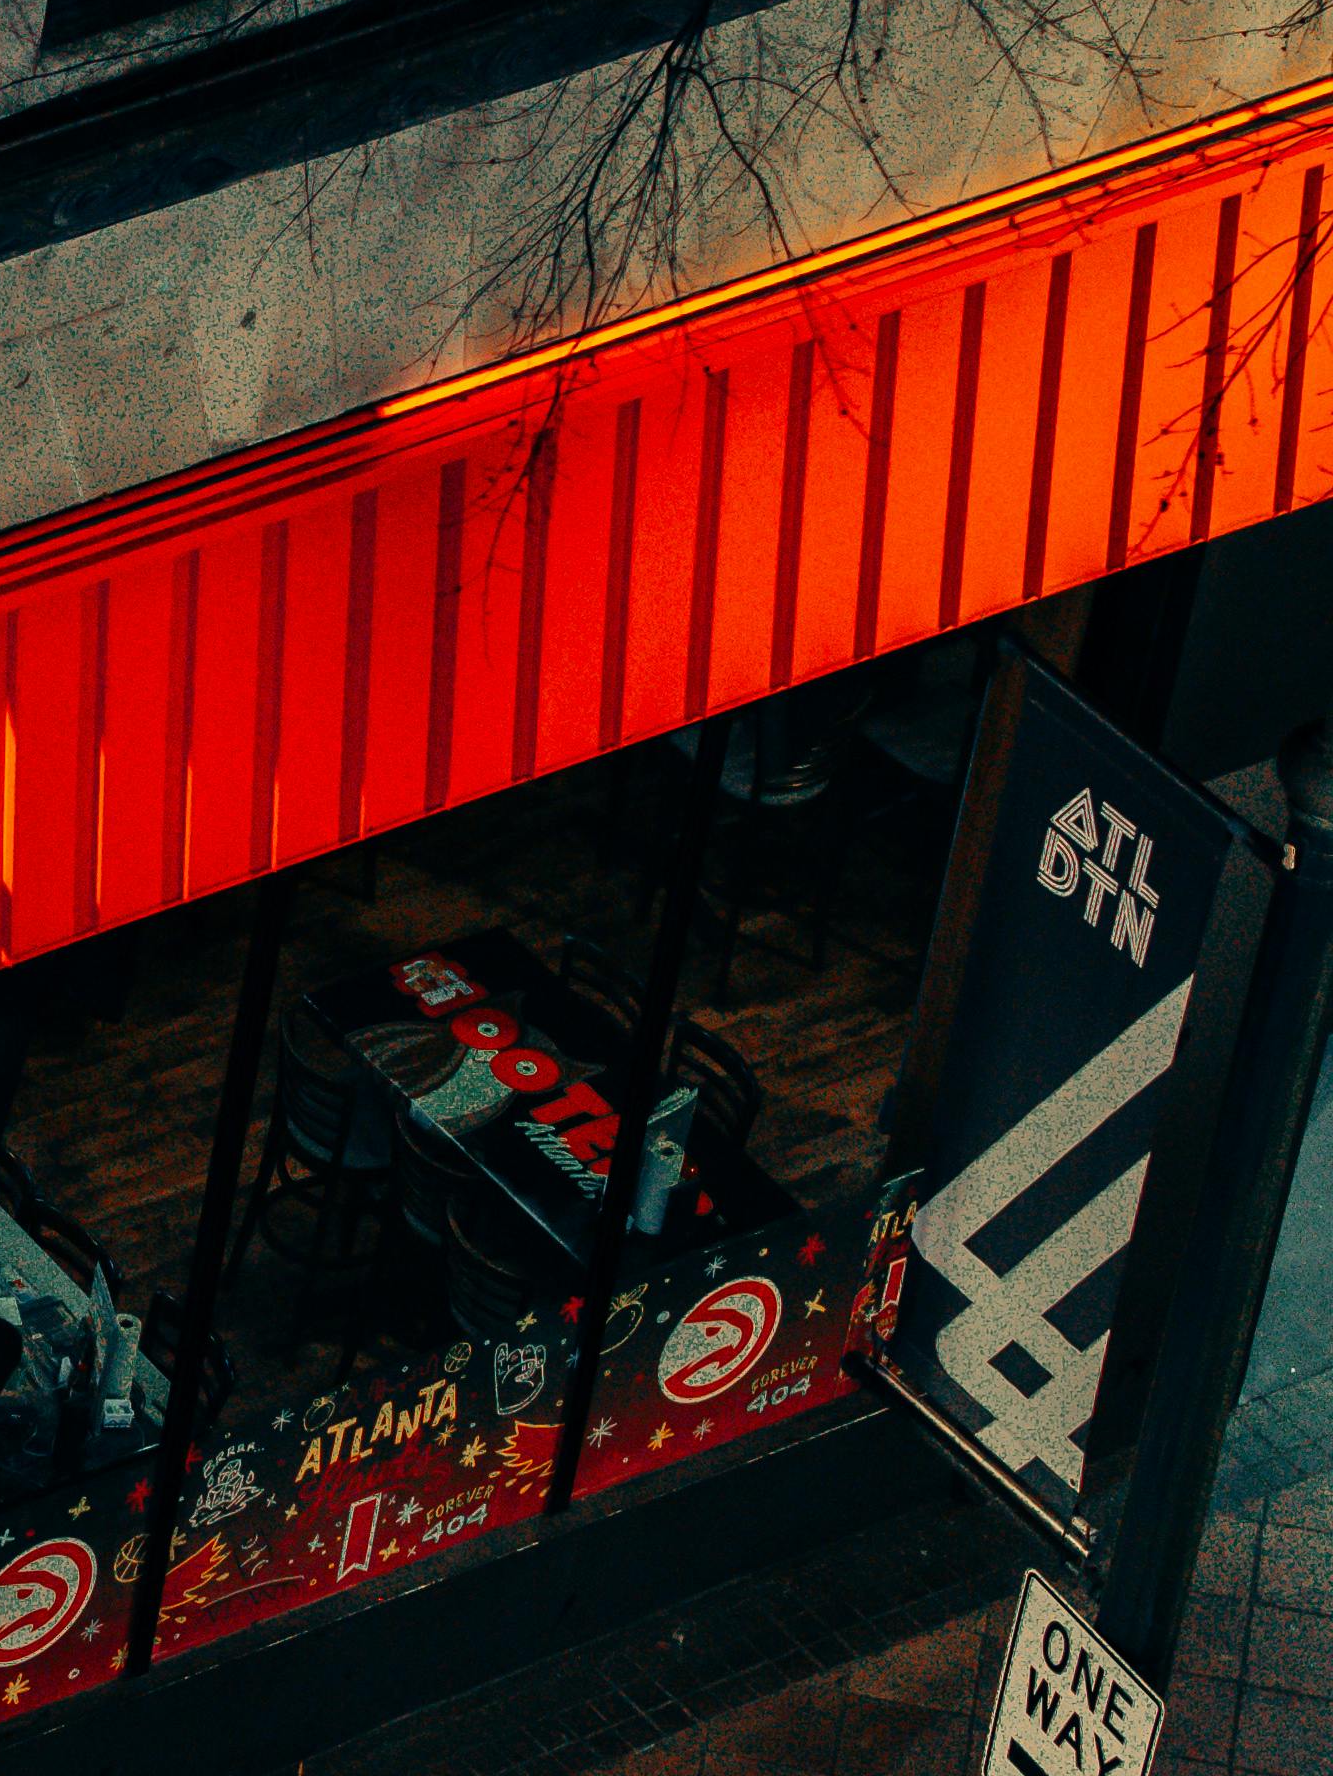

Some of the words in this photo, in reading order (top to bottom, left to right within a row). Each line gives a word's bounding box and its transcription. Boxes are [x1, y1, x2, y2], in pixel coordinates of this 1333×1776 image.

[1049, 787, 1161, 909] ATL
[1036, 826, 1157, 969] DTN
[868, 1200, 919, 1247] ATLA
[745, 1373, 812, 1414] 404
[750, 1355, 819, 1395] FOREVER
[295, 1378, 459, 1483] ATLANTA
[421, 1503, 489, 1543] 404
[425, 1483, 495, 1524] FOREVER
[1041, 1619, 1134, 1732] ONE
